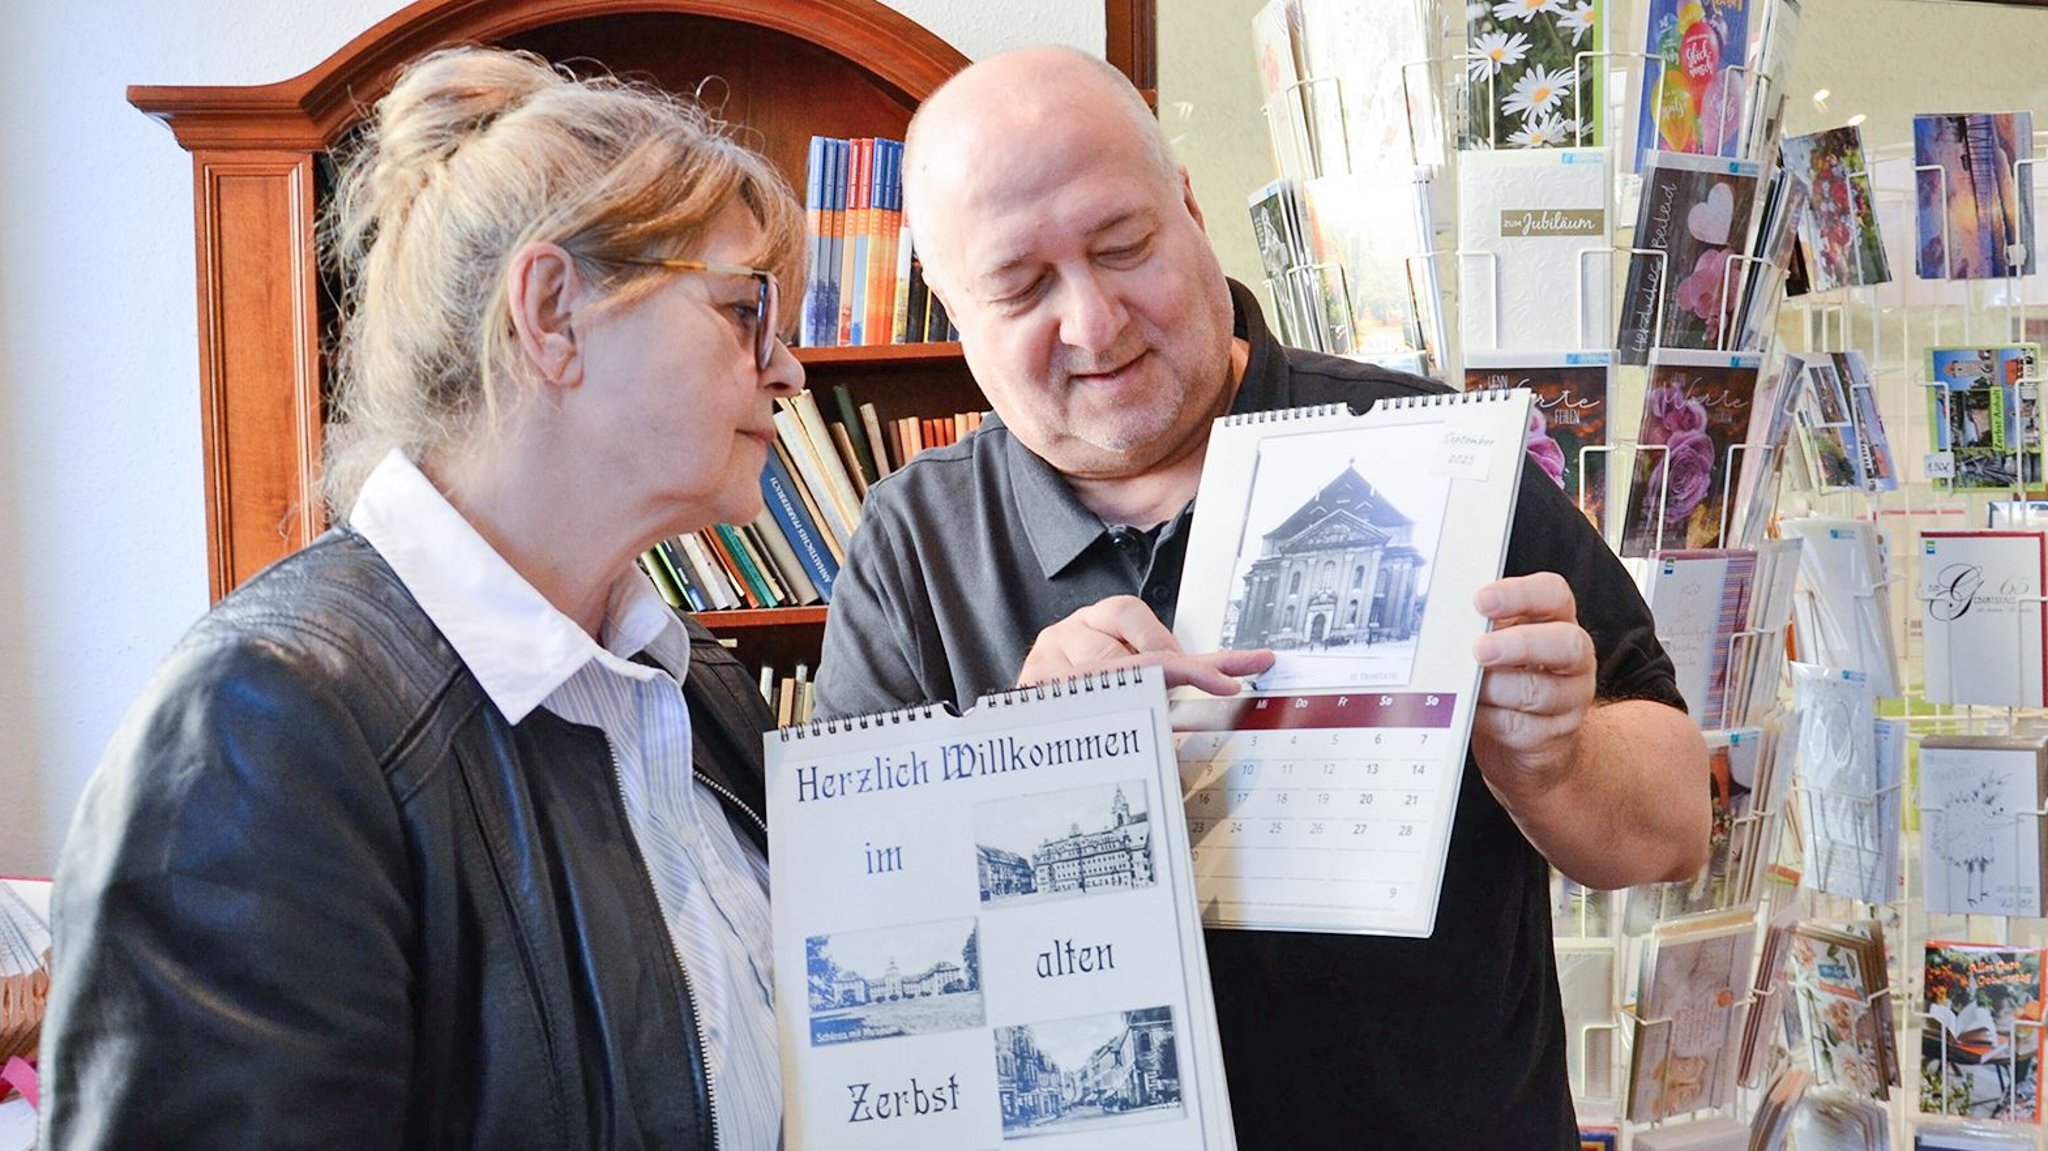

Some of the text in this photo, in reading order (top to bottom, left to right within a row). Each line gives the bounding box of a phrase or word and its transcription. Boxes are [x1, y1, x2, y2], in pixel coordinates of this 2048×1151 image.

[1522, 211, 1595, 235] Jubiläum
[1650, 183, 1677, 249] Beileid
[1295, 698, 1308, 709] Do
[1338, 696, 1349, 707] Fr
[1380, 695, 1393, 706] Sa
[1425, 695, 1440, 706] So
[1374, 733, 1381, 744] 6
[1421, 734, 1428, 745] 7
[796, 727, 1140, 803] Herzlich Willkommen
[1243, 764, 1255, 775] 10
[1367, 763, 1379, 774] 13
[1412, 764, 1425, 775] 14
[1237, 793, 1249, 803] 17
[1360, 793, 1373, 804] 20
[1404, 794, 1418, 805] 21
[1192, 822, 1204, 833] 23
[1269, 822, 1282, 834] 25
[1353, 824, 1368, 835] 27
[1398, 825, 1413, 837] 28
[864, 841, 903, 875] im
[1036, 938, 1115, 979] alten
[847, 1071, 960, 1124] Zerbst
